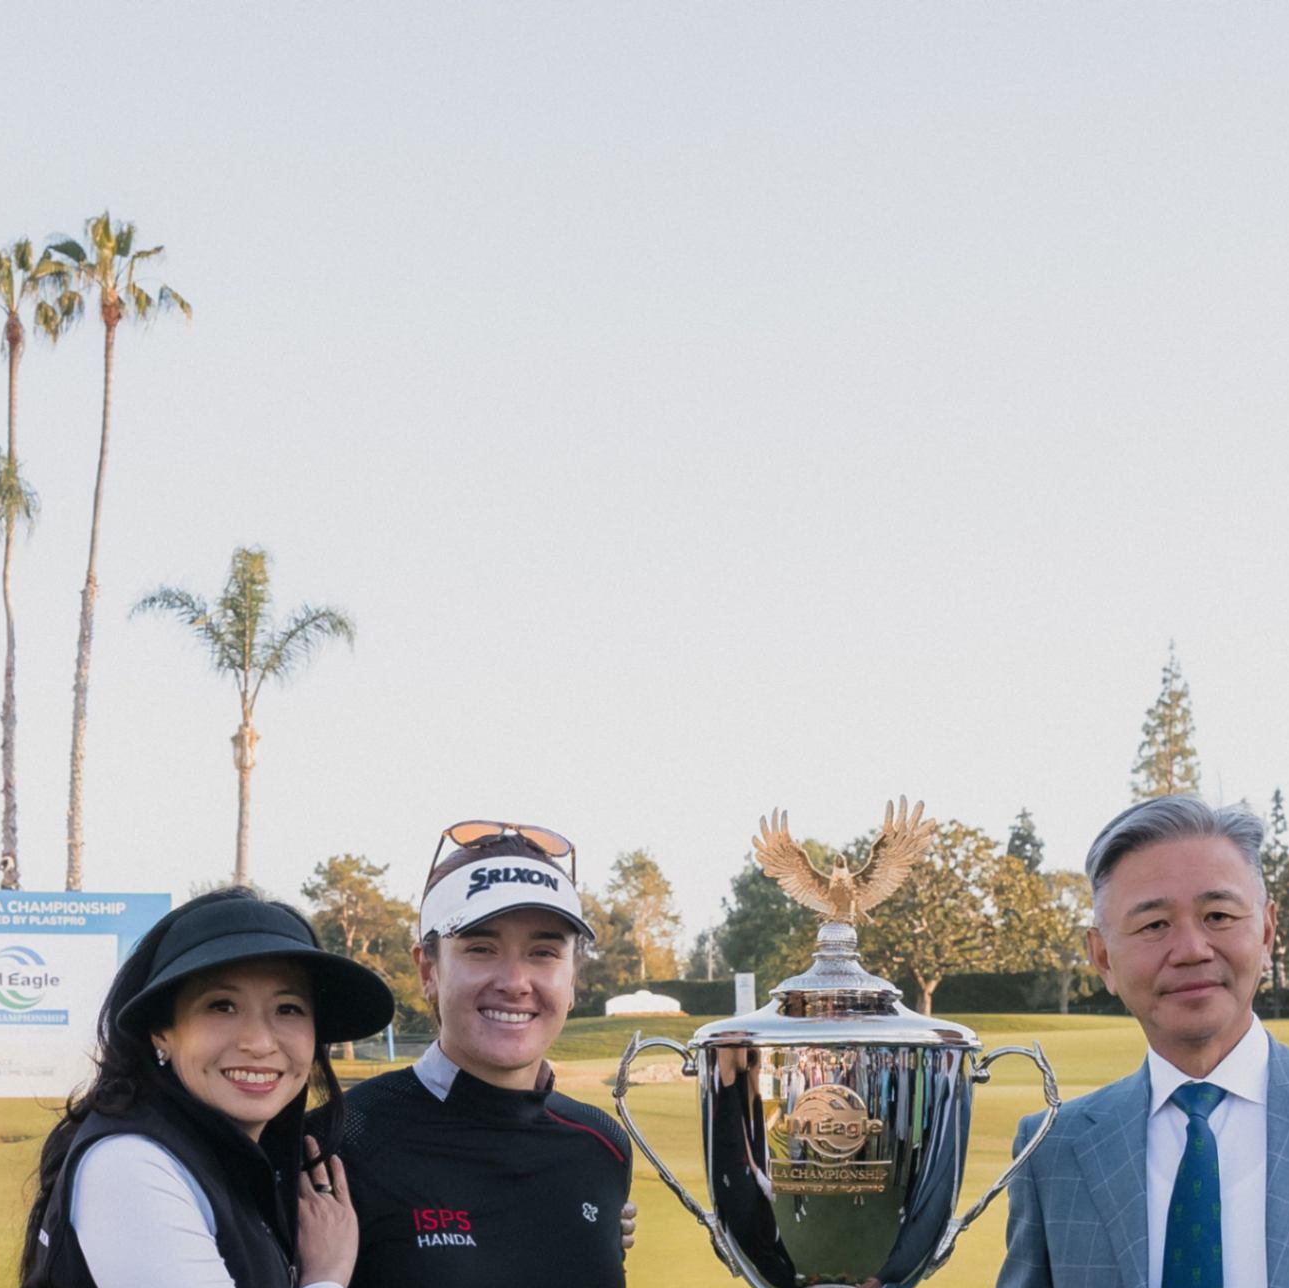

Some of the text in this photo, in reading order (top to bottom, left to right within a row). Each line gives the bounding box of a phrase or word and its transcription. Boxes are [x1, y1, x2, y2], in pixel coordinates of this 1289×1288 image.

[466, 867, 559, 901] SRIXON
[8, 901, 126, 915] CHAMPIONSHIP
[12, 915, 28, 926] BY
[30, 915, 87, 926] PLASTPRO
[8, 971, 61, 989] Eagle
[816, 1116, 884, 1139] Eagle
[774, 1168, 888, 1180] LA CHAMPIONSHIP
[413, 1208, 473, 1232] ISPS
[417, 1233, 477, 1248] HANDA
